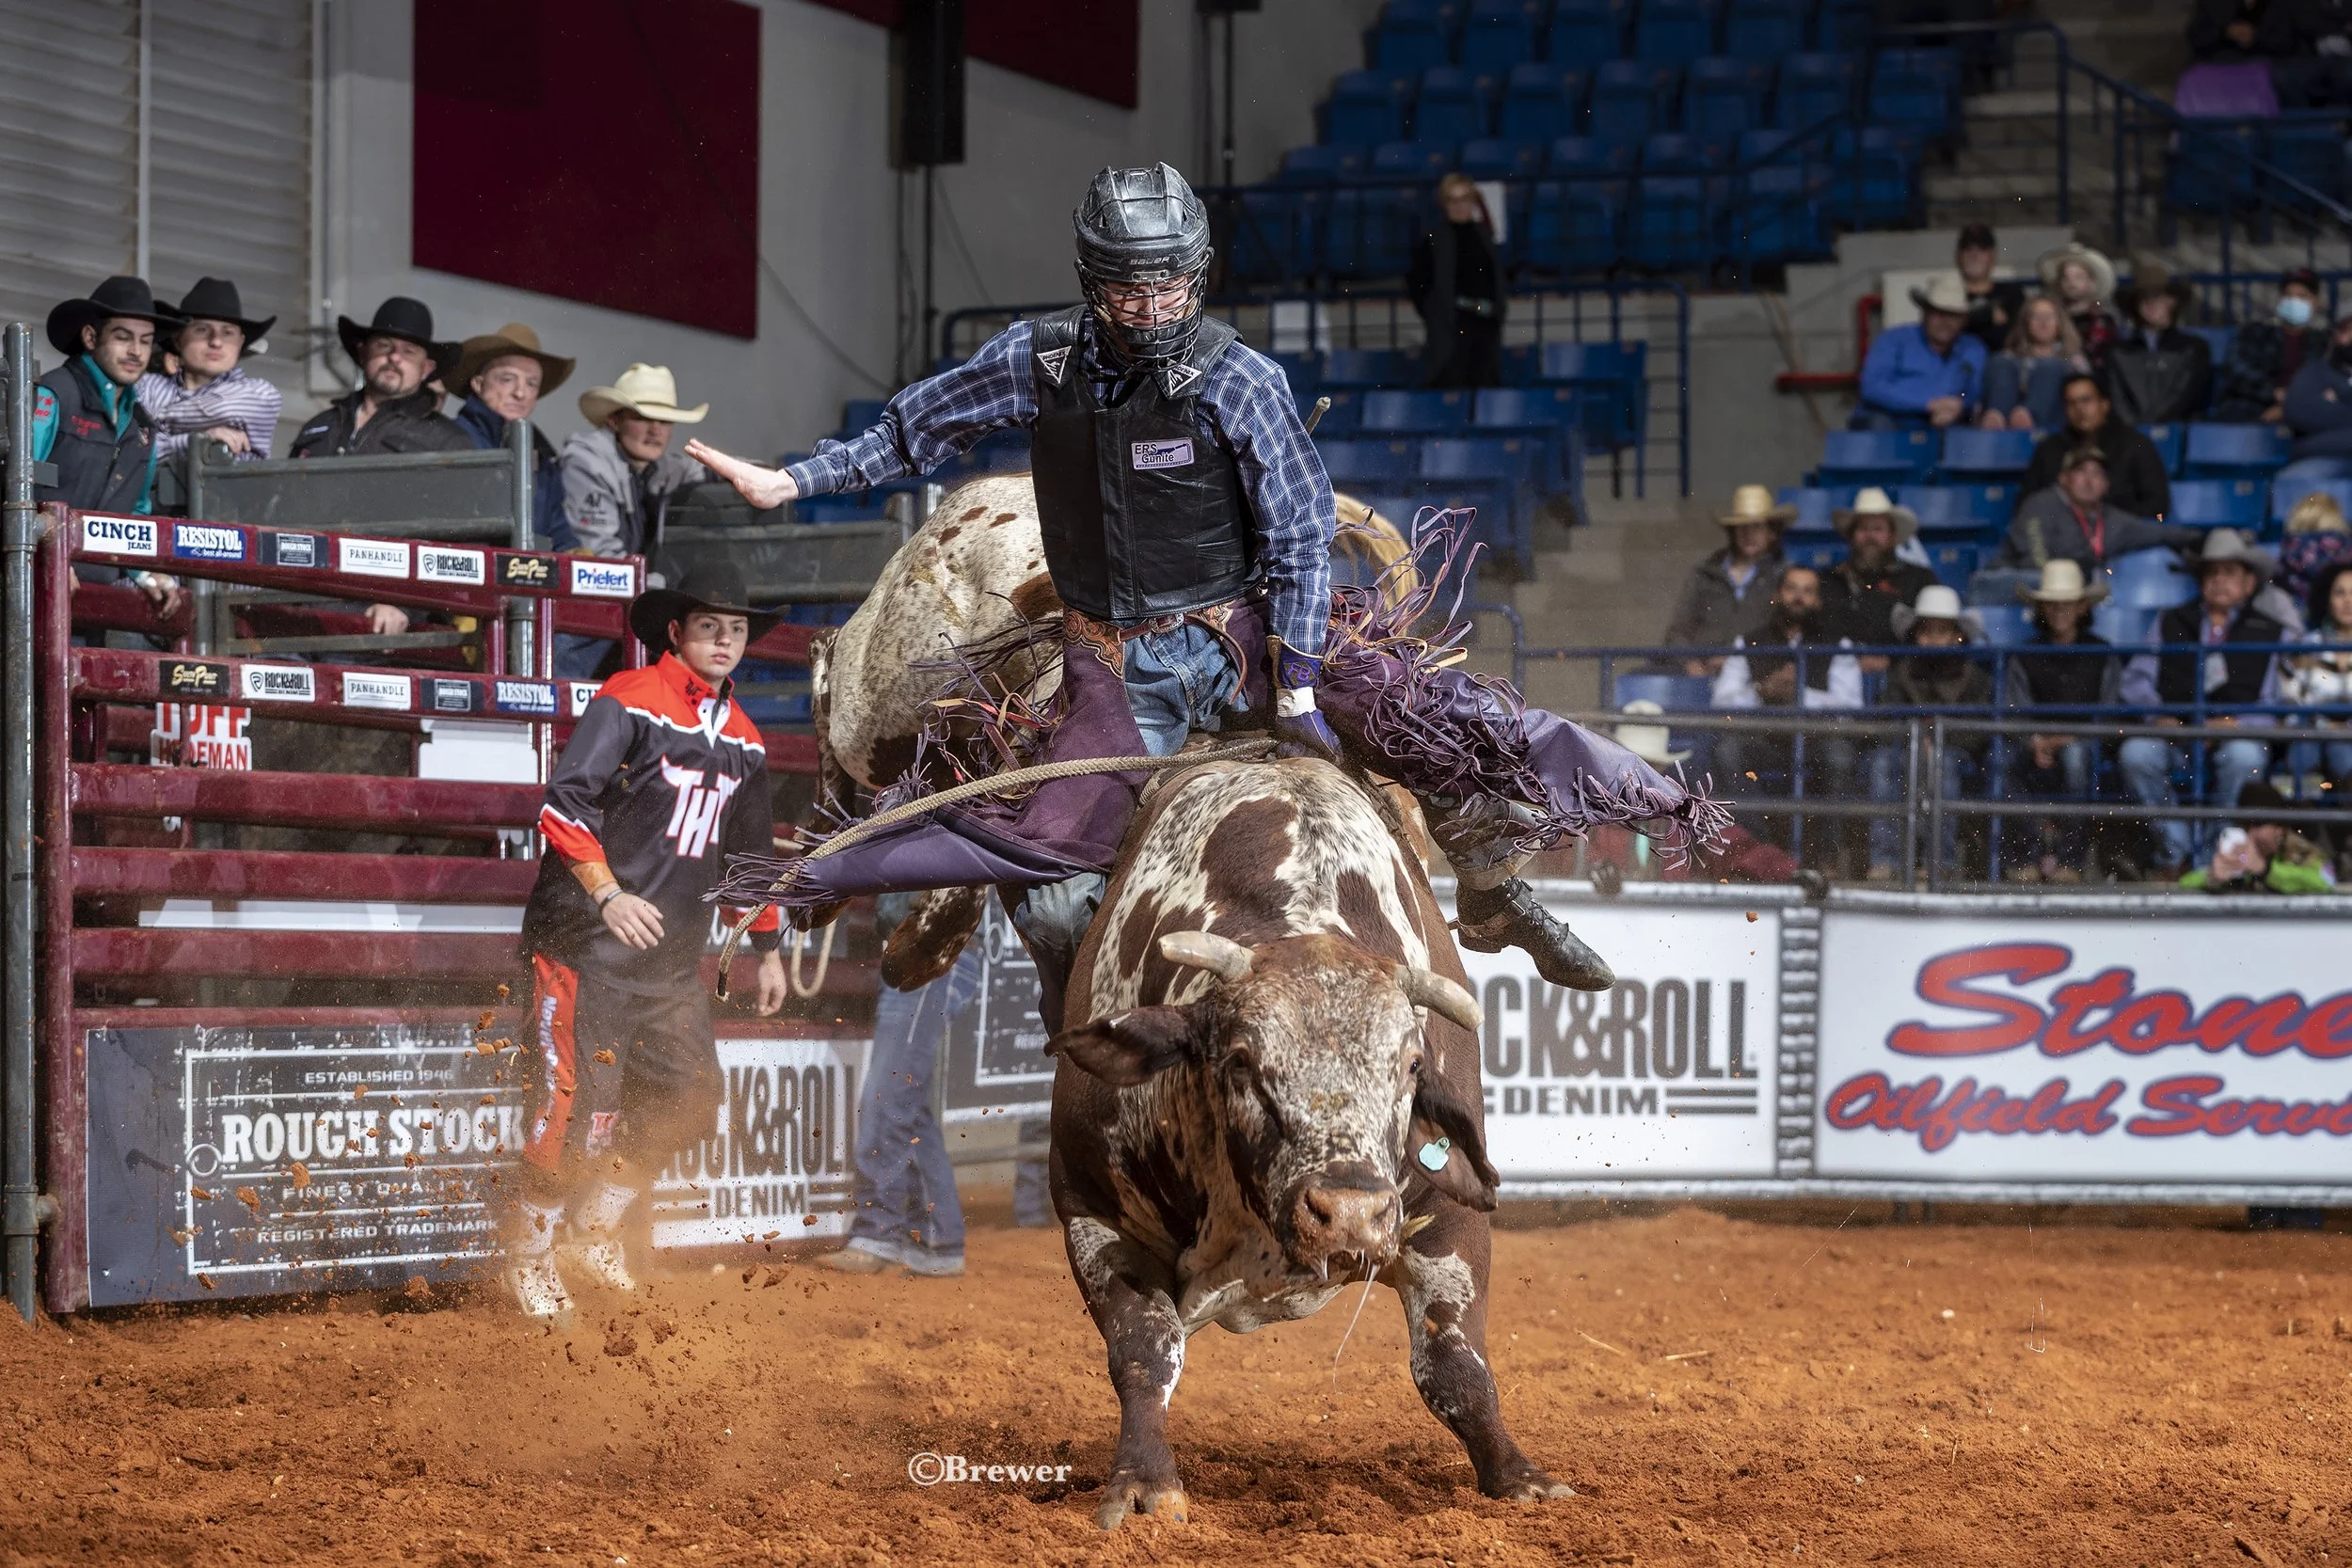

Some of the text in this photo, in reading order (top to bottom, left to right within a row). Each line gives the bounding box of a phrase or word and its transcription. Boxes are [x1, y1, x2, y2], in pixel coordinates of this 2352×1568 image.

[1135, 443, 1157, 455] ERS
[1141, 452, 1174, 464] Gunite
[87, 520, 152, 542] CINCH
[176, 525, 243, 551] RESISTOL
[128, 541, 152, 551] JEANS
[349, 548, 404, 563] PANHANDLE
[437, 554, 479, 573] ROCK&ROLL
[578, 567, 628, 586] Priefert
[264, 672, 310, 689] ROCK&ROLL
[350, 682, 405, 696] PANHANDLE
[496, 682, 555, 705] RESISTOL
[159, 737, 247, 769] HEMAN
[1468, 974, 1758, 1079] CK&ROLL
[305, 1069, 454, 1085] ESTABLISHED 1946
[1502, 1086, 1658, 1116] DENIM
[1825, 1069, 2127, 1154] Oilfield
[222, 1108, 379, 1164] ROUGH
[389, 1104, 525, 1157] STOCK
[716, 1183, 806, 1218] DENIM
[258, 1219, 498, 1243] REGISTERED TRADEMARK
